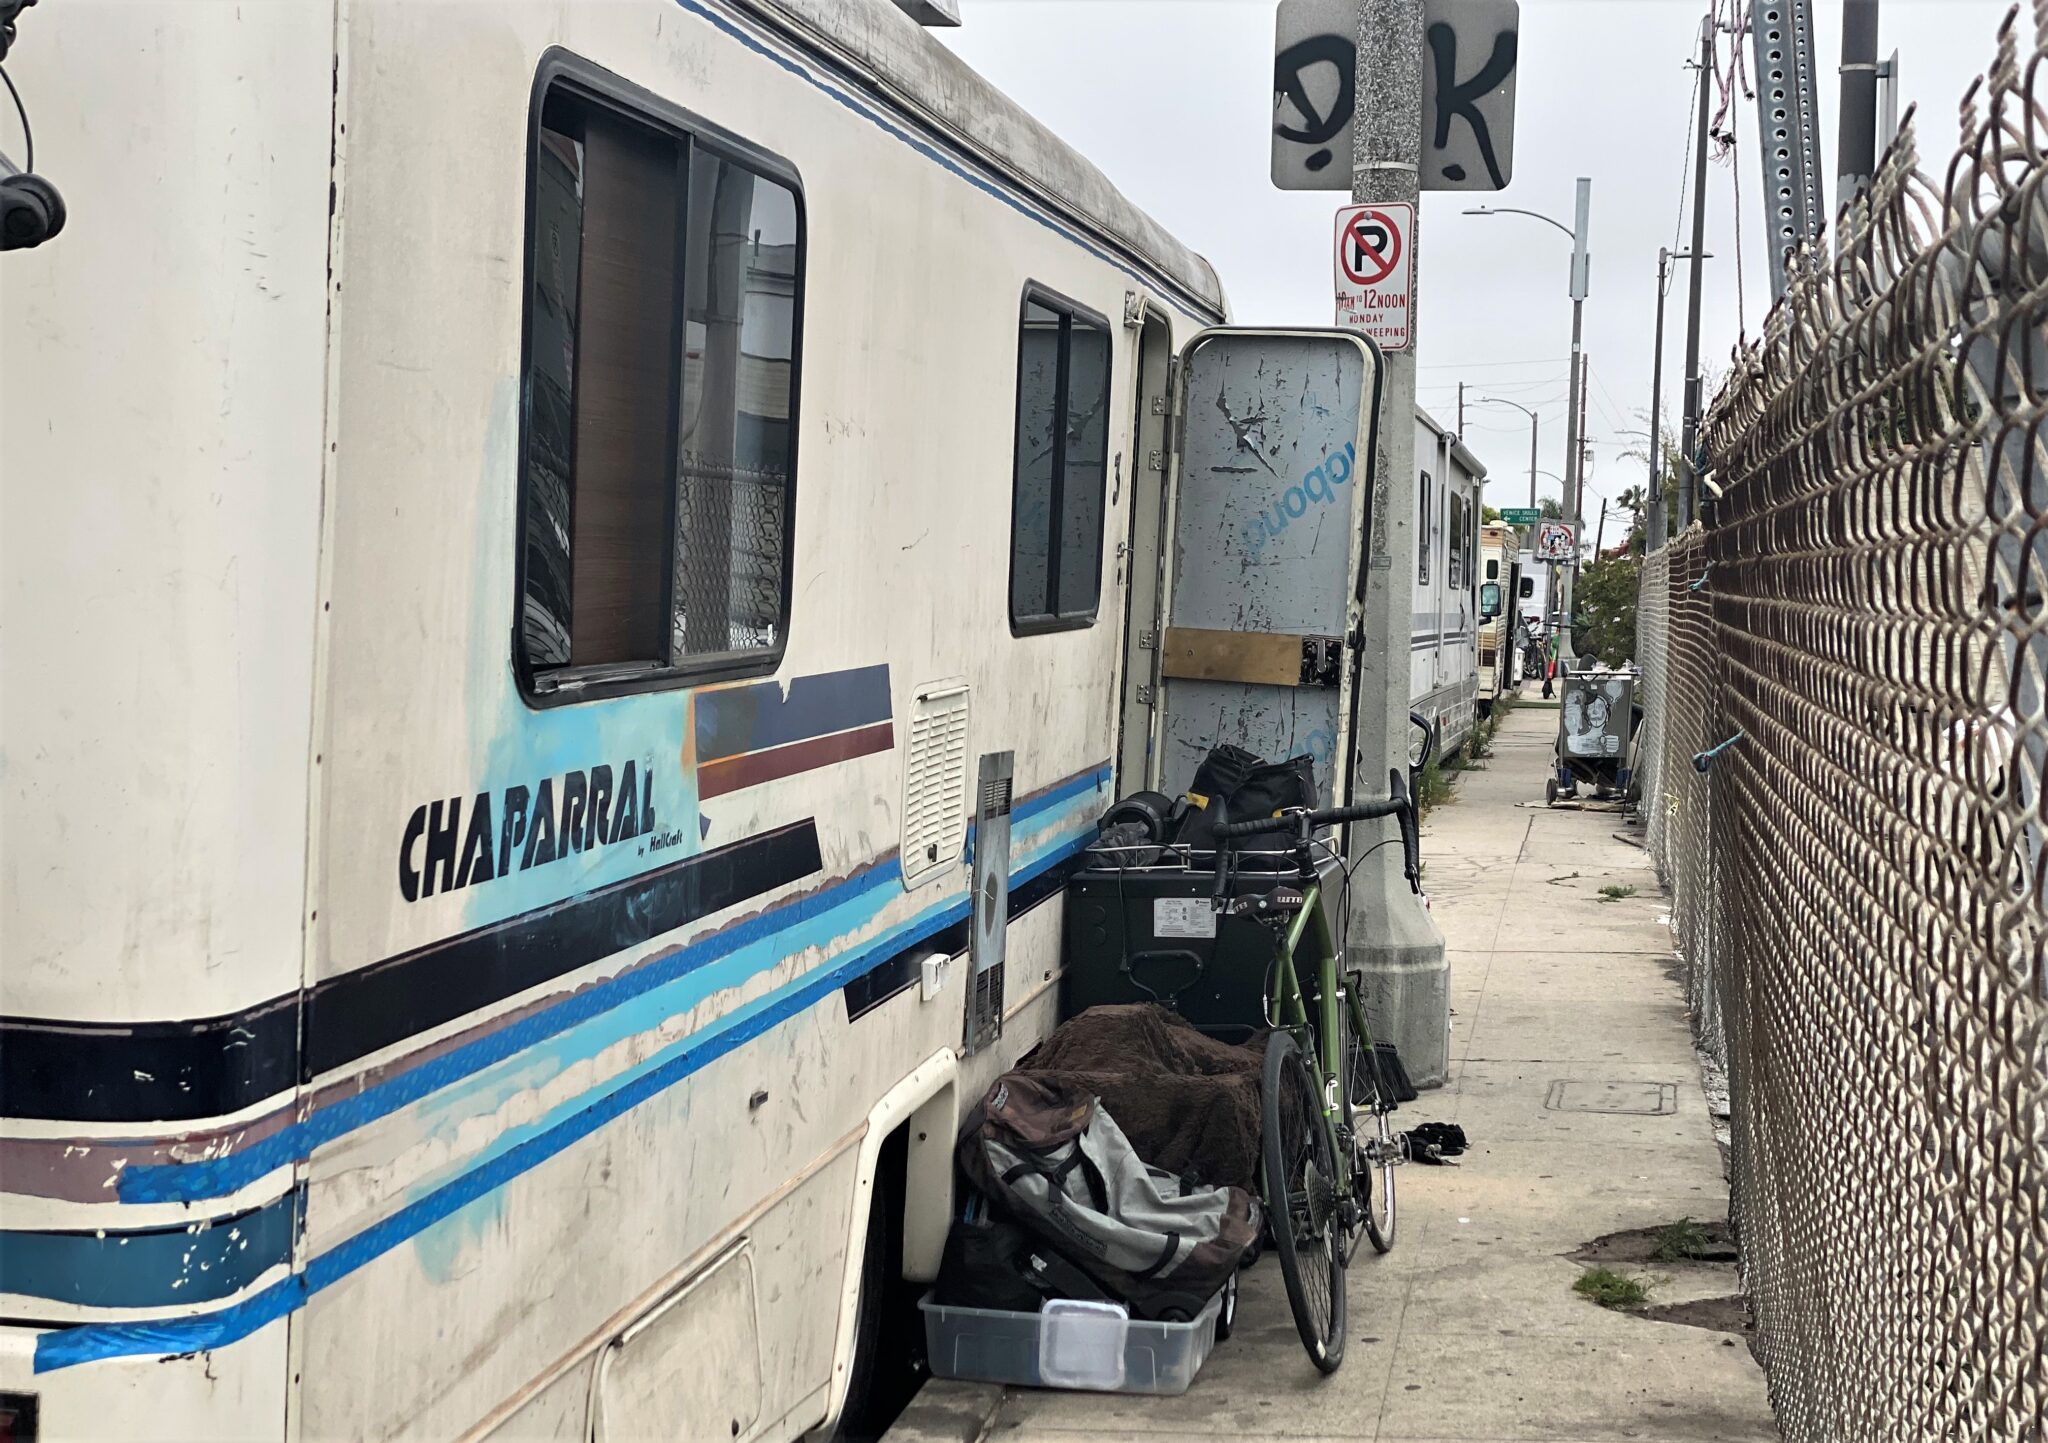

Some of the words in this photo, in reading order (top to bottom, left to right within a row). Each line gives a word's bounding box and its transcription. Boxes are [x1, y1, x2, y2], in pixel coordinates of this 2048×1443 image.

[1349, 314, 1384, 323] MONDAY
[1362, 327, 1406, 337] WEEPING
[399, 757, 656, 903] CHAPARRAL
